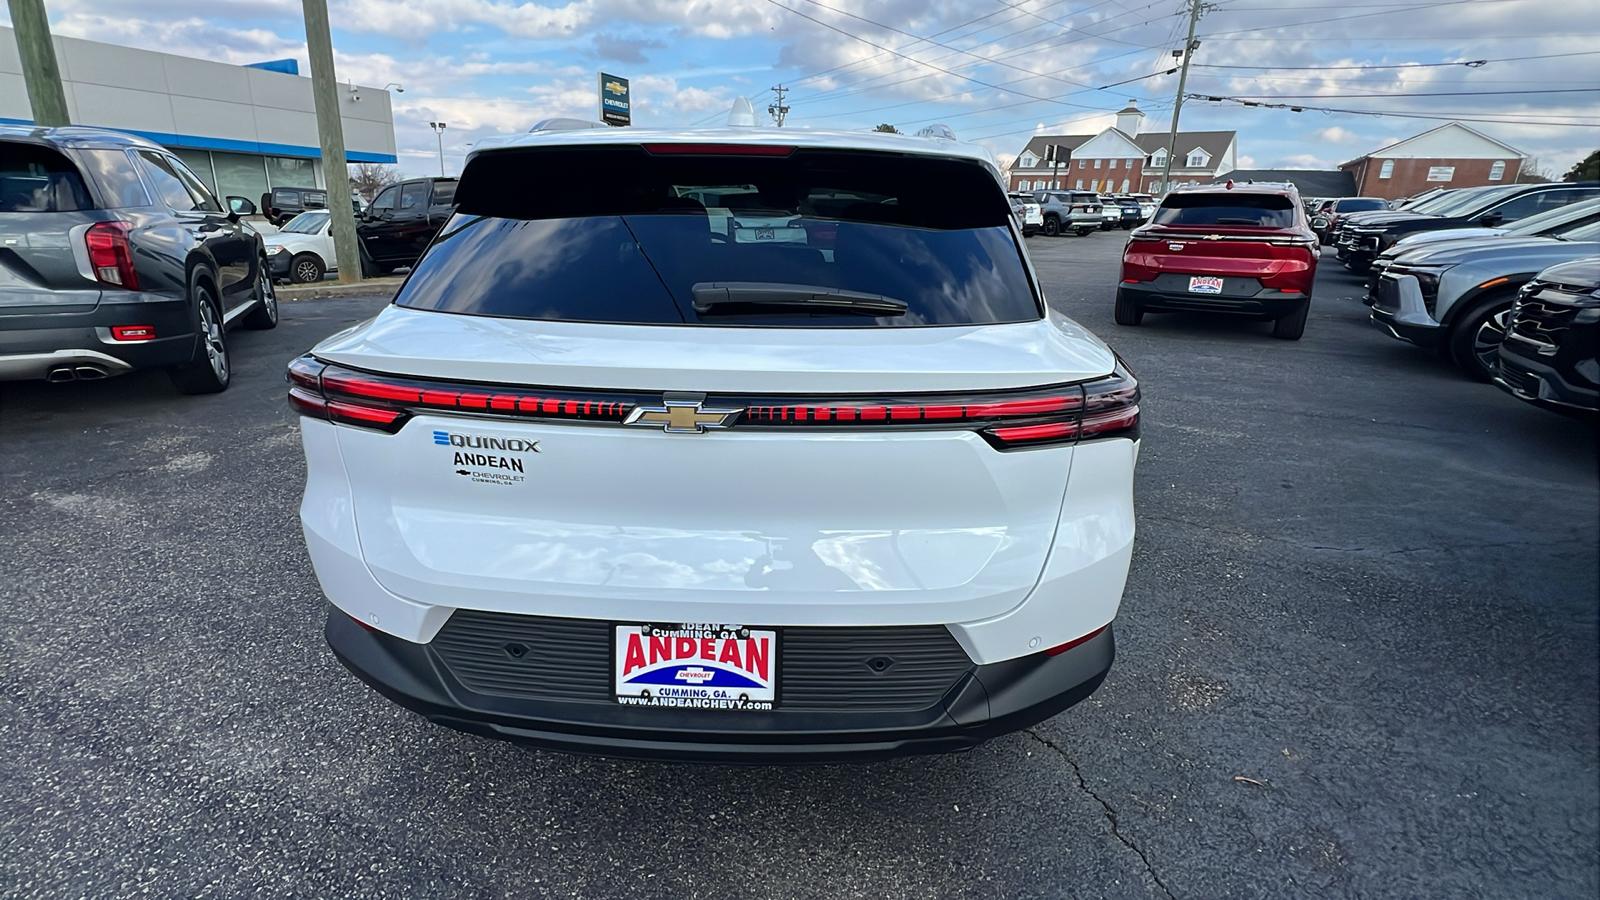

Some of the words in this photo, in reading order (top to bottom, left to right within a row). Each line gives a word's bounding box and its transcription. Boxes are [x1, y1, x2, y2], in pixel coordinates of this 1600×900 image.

[433, 431, 541, 453] EQUINOX
[454, 452, 524, 473] ANDEAN
[472, 471, 525, 482] CHEVROLET
[652, 628, 717, 639] CUMMING,
[720, 630, 738, 640] GA
[623, 633, 769, 682] ANDEAN
[658, 687, 711, 699] CUMMING,
[713, 689, 732, 699] GA.
[618, 696, 772, 710] www.ANDEANCHEVY.com
